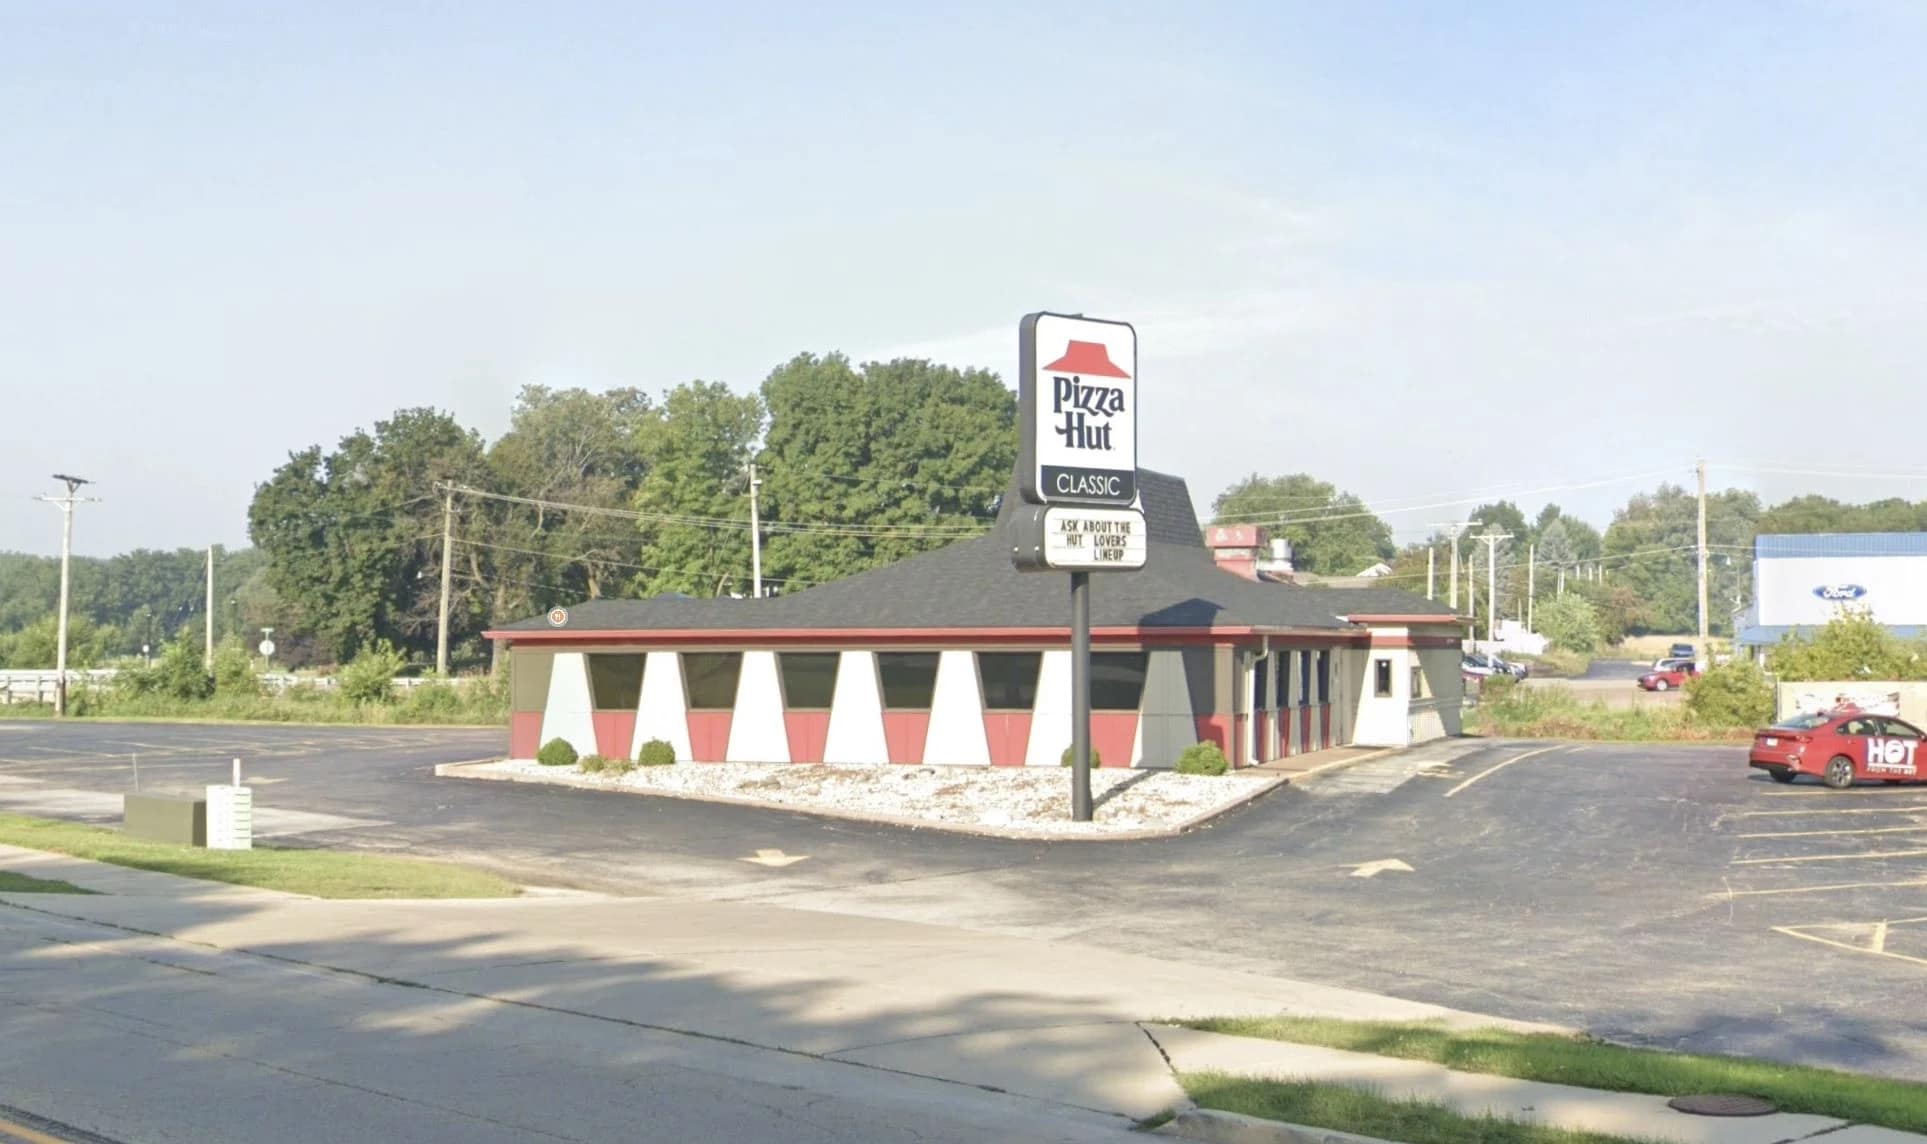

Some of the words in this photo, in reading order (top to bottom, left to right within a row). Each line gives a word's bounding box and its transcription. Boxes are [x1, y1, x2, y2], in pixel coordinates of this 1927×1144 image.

[1053, 376, 1125, 417] Pizza
[1055, 411, 1113, 451] Hut
[1056, 473, 1121, 496] CLASSIC
[1061, 520, 1078, 532] ASK
[1083, 521, 1112, 533] ABOUT
[1114, 521, 1131, 534] THE
[1066, 534, 1083, 546] HUT
[1094, 535, 1127, 547] LOVERS
[1094, 549, 1124, 561] LINEUP
[1823, 584, 1856, 600] Ford
[1868, 738, 1919, 766] HOT
